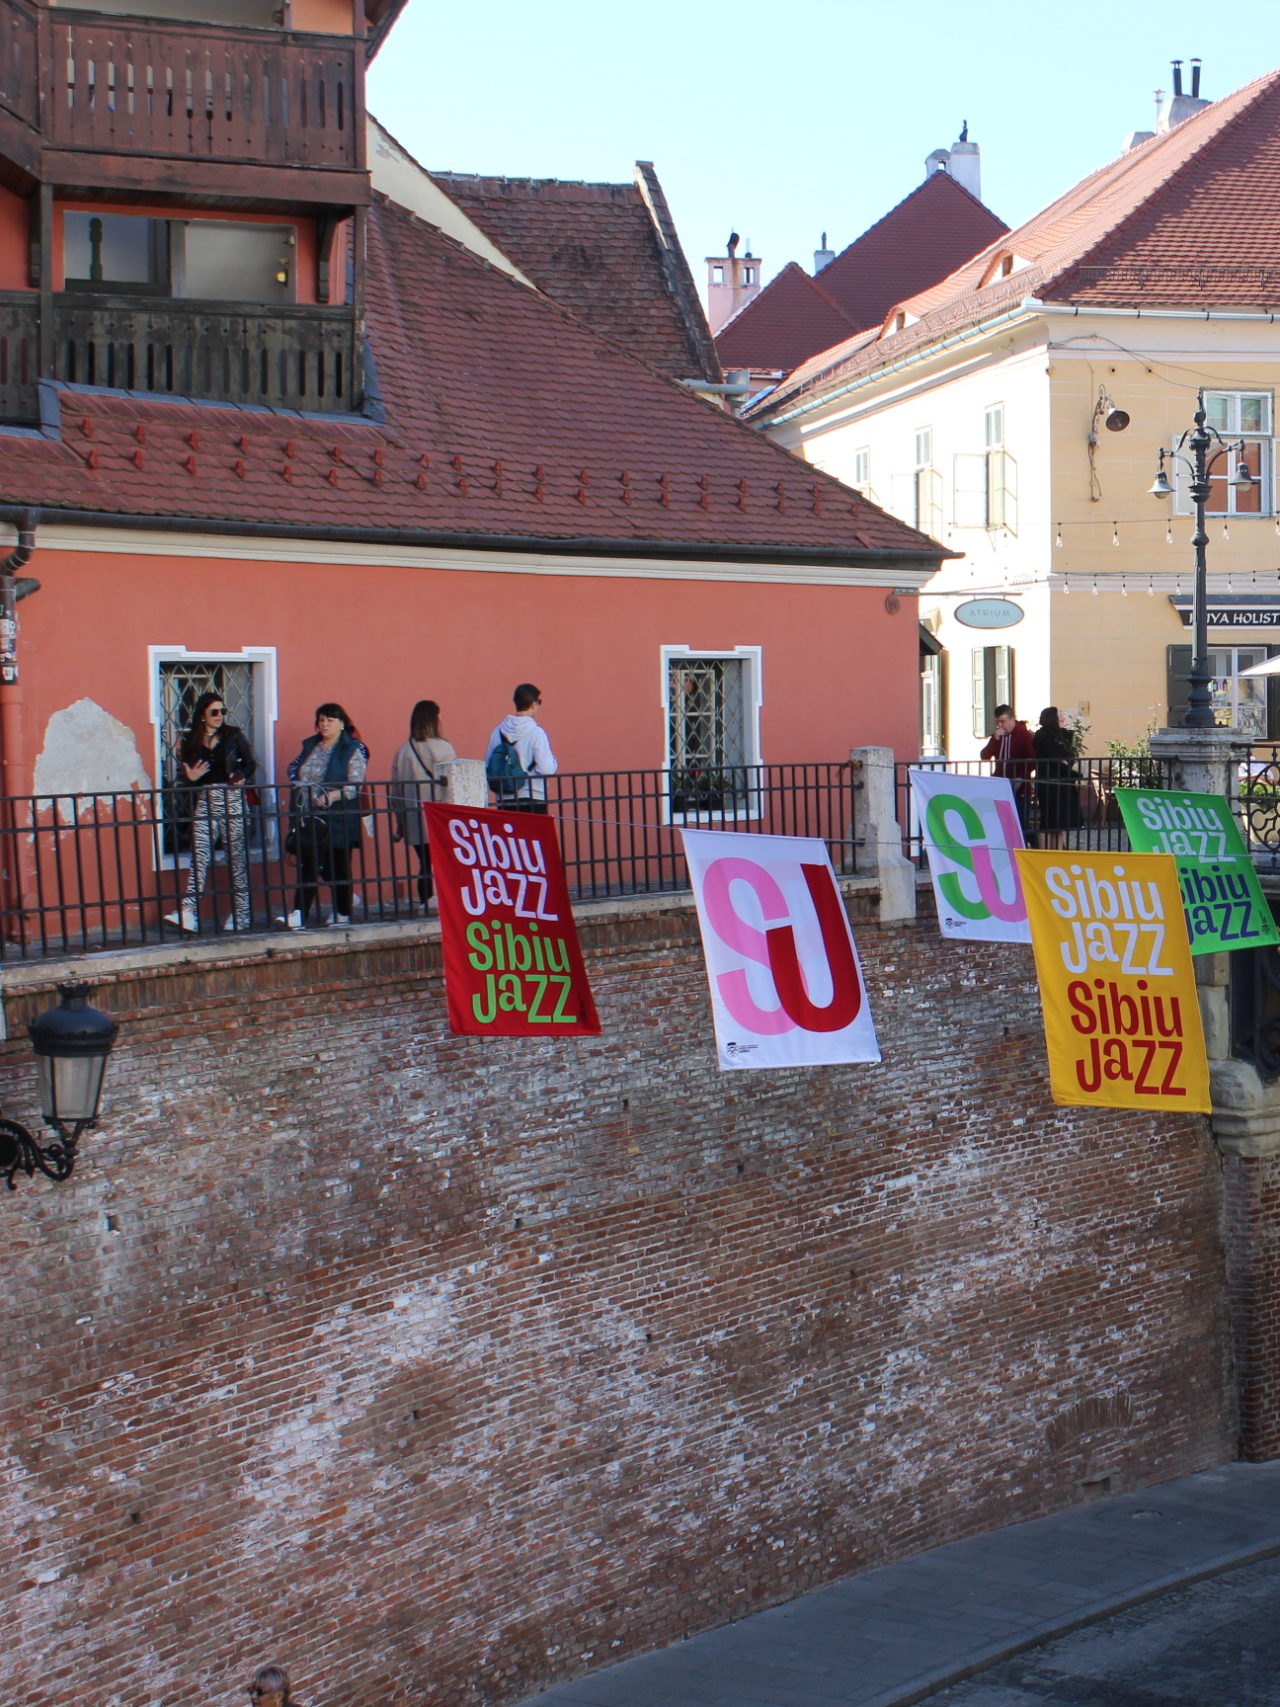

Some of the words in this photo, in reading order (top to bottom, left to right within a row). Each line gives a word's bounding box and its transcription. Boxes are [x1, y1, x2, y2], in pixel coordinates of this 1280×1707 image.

[969, 608, 1010, 617] ATRIUM
[1136, 796, 1224, 831] Sibiu
[448, 818, 547, 875] Sibiu
[1044, 864, 1165, 921] Sibiu
[1178, 865, 1252, 905] ibiu
[465, 919, 571, 972] Sibiu
[1067, 979, 1184, 1038] Sibiu
